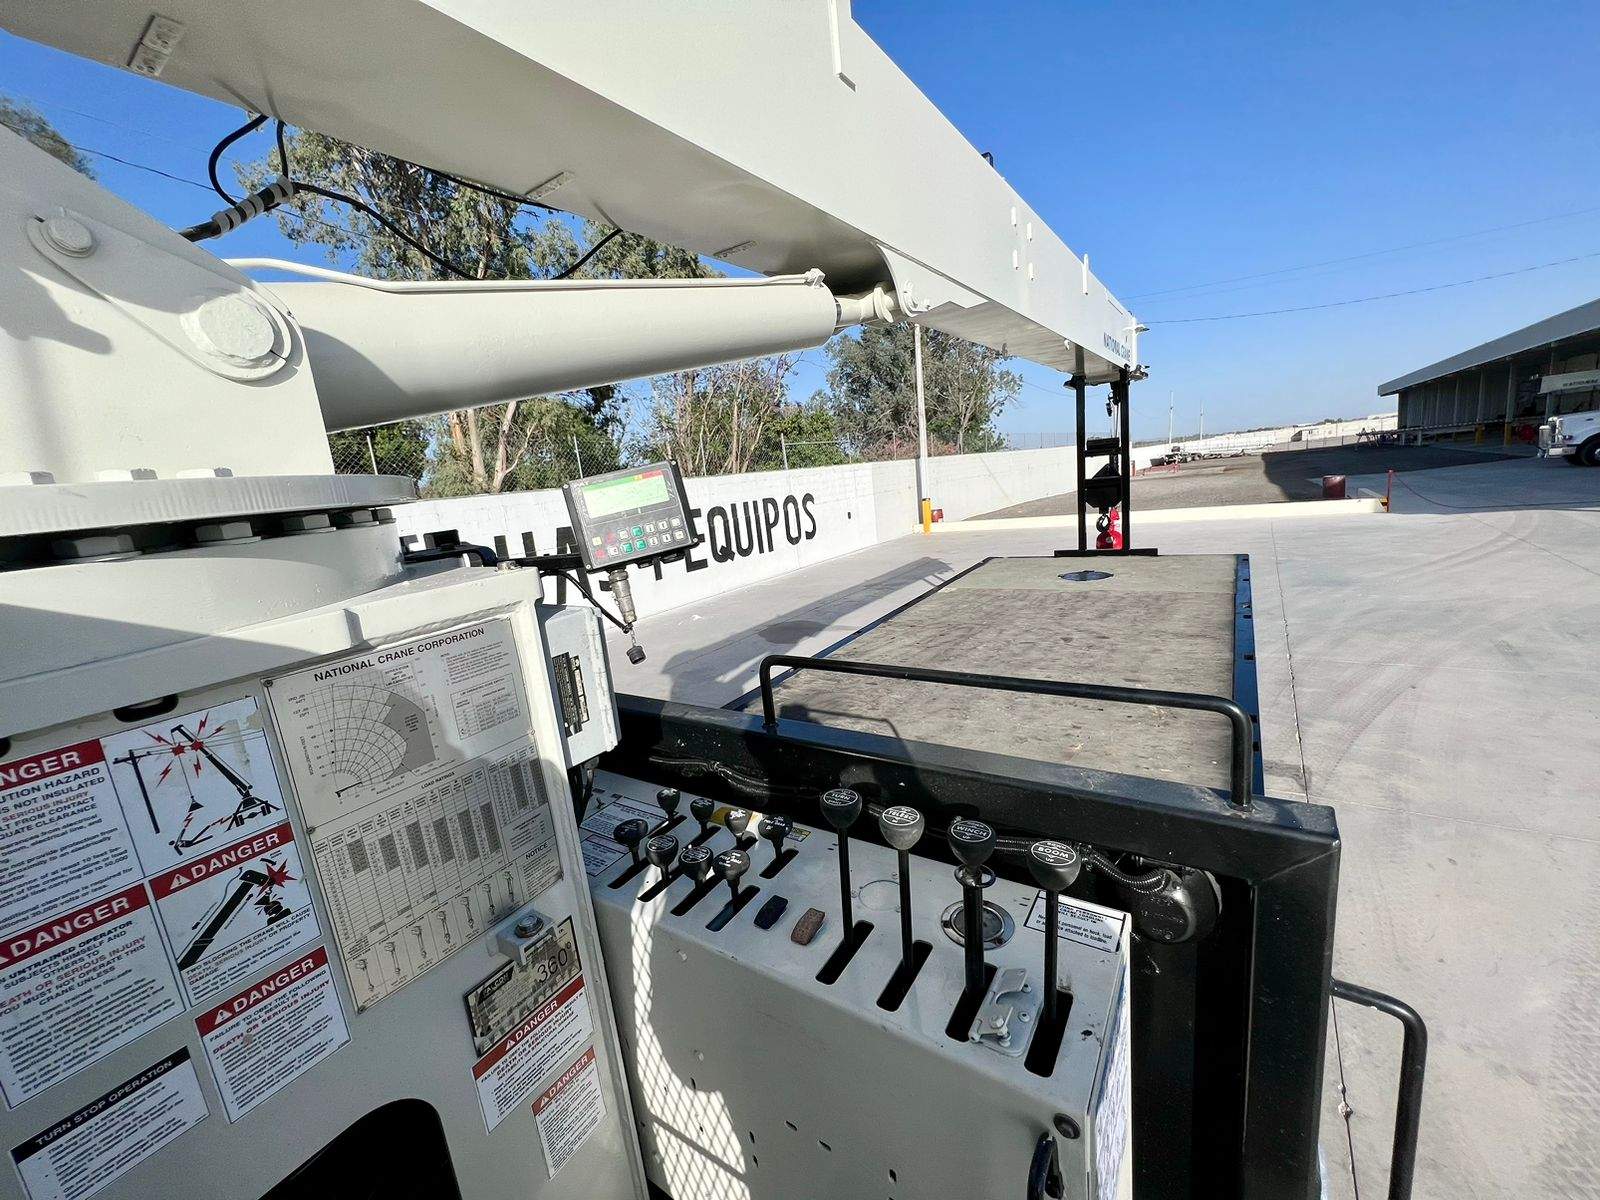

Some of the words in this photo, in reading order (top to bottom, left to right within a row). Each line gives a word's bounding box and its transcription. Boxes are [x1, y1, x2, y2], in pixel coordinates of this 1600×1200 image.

[684, 492, 818, 573] EQUIPOS
[313, 659, 375, 682] NATIONAL
[377, 647, 415, 665] CRANE
[417, 628, 485, 653] CORPORATION
[0, 751, 80, 786] NGER
[44, 767, 101, 790] HAZARD
[1, 802, 50, 823] SERIOUS
[13, 796, 41, 809] NOT
[41, 777, 106, 801] INSULATED
[14, 811, 46, 826] FROM
[48, 796, 96, 816] CONTACT
[34, 802, 97, 828] CLEARANCE
[956, 825, 987, 837] WINCH
[190, 832, 280, 880] DANGER
[525, 841, 548, 860] NOTICE
[1037, 846, 1069, 859] BOOM
[9, 895, 131, 959] DANGER
[3, 959, 61, 991] SUBJECTS
[62, 939, 104, 963] HIMSELF
[106, 929, 127, 943] AND
[11, 944, 77, 979] UNTRAINED
[78, 919, 133, 948] OPERATOR
[42, 956, 85, 980] OTHERS
[86, 949, 100, 959] TO
[56, 953, 106, 983] SERIOUS
[108, 934, 146, 957] INJURY
[23, 987, 53, 1006] MUST
[55, 976, 76, 991] NOT
[77, 953, 125, 980] OPERATE
[124, 942, 147, 957] THIS
[38, 984, 74, 1007] CRANE
[76, 964, 116, 988] UNLESS
[232, 957, 314, 1012] DANGER
[288, 969, 326, 995] FOLLOWING
[212, 1032, 244, 1054] DEATH
[245, 1022, 259, 1034] OR
[261, 998, 299, 1024] SERIOUS
[300, 979, 330, 1000] INJURY
[515, 999, 558, 1042] DANGER
[549, 1057, 589, 1097] DANGER
[35, 1119, 72, 1146] TURN
[72, 1098, 107, 1123] STOP
[107, 1059, 172, 1103] OPERATION
